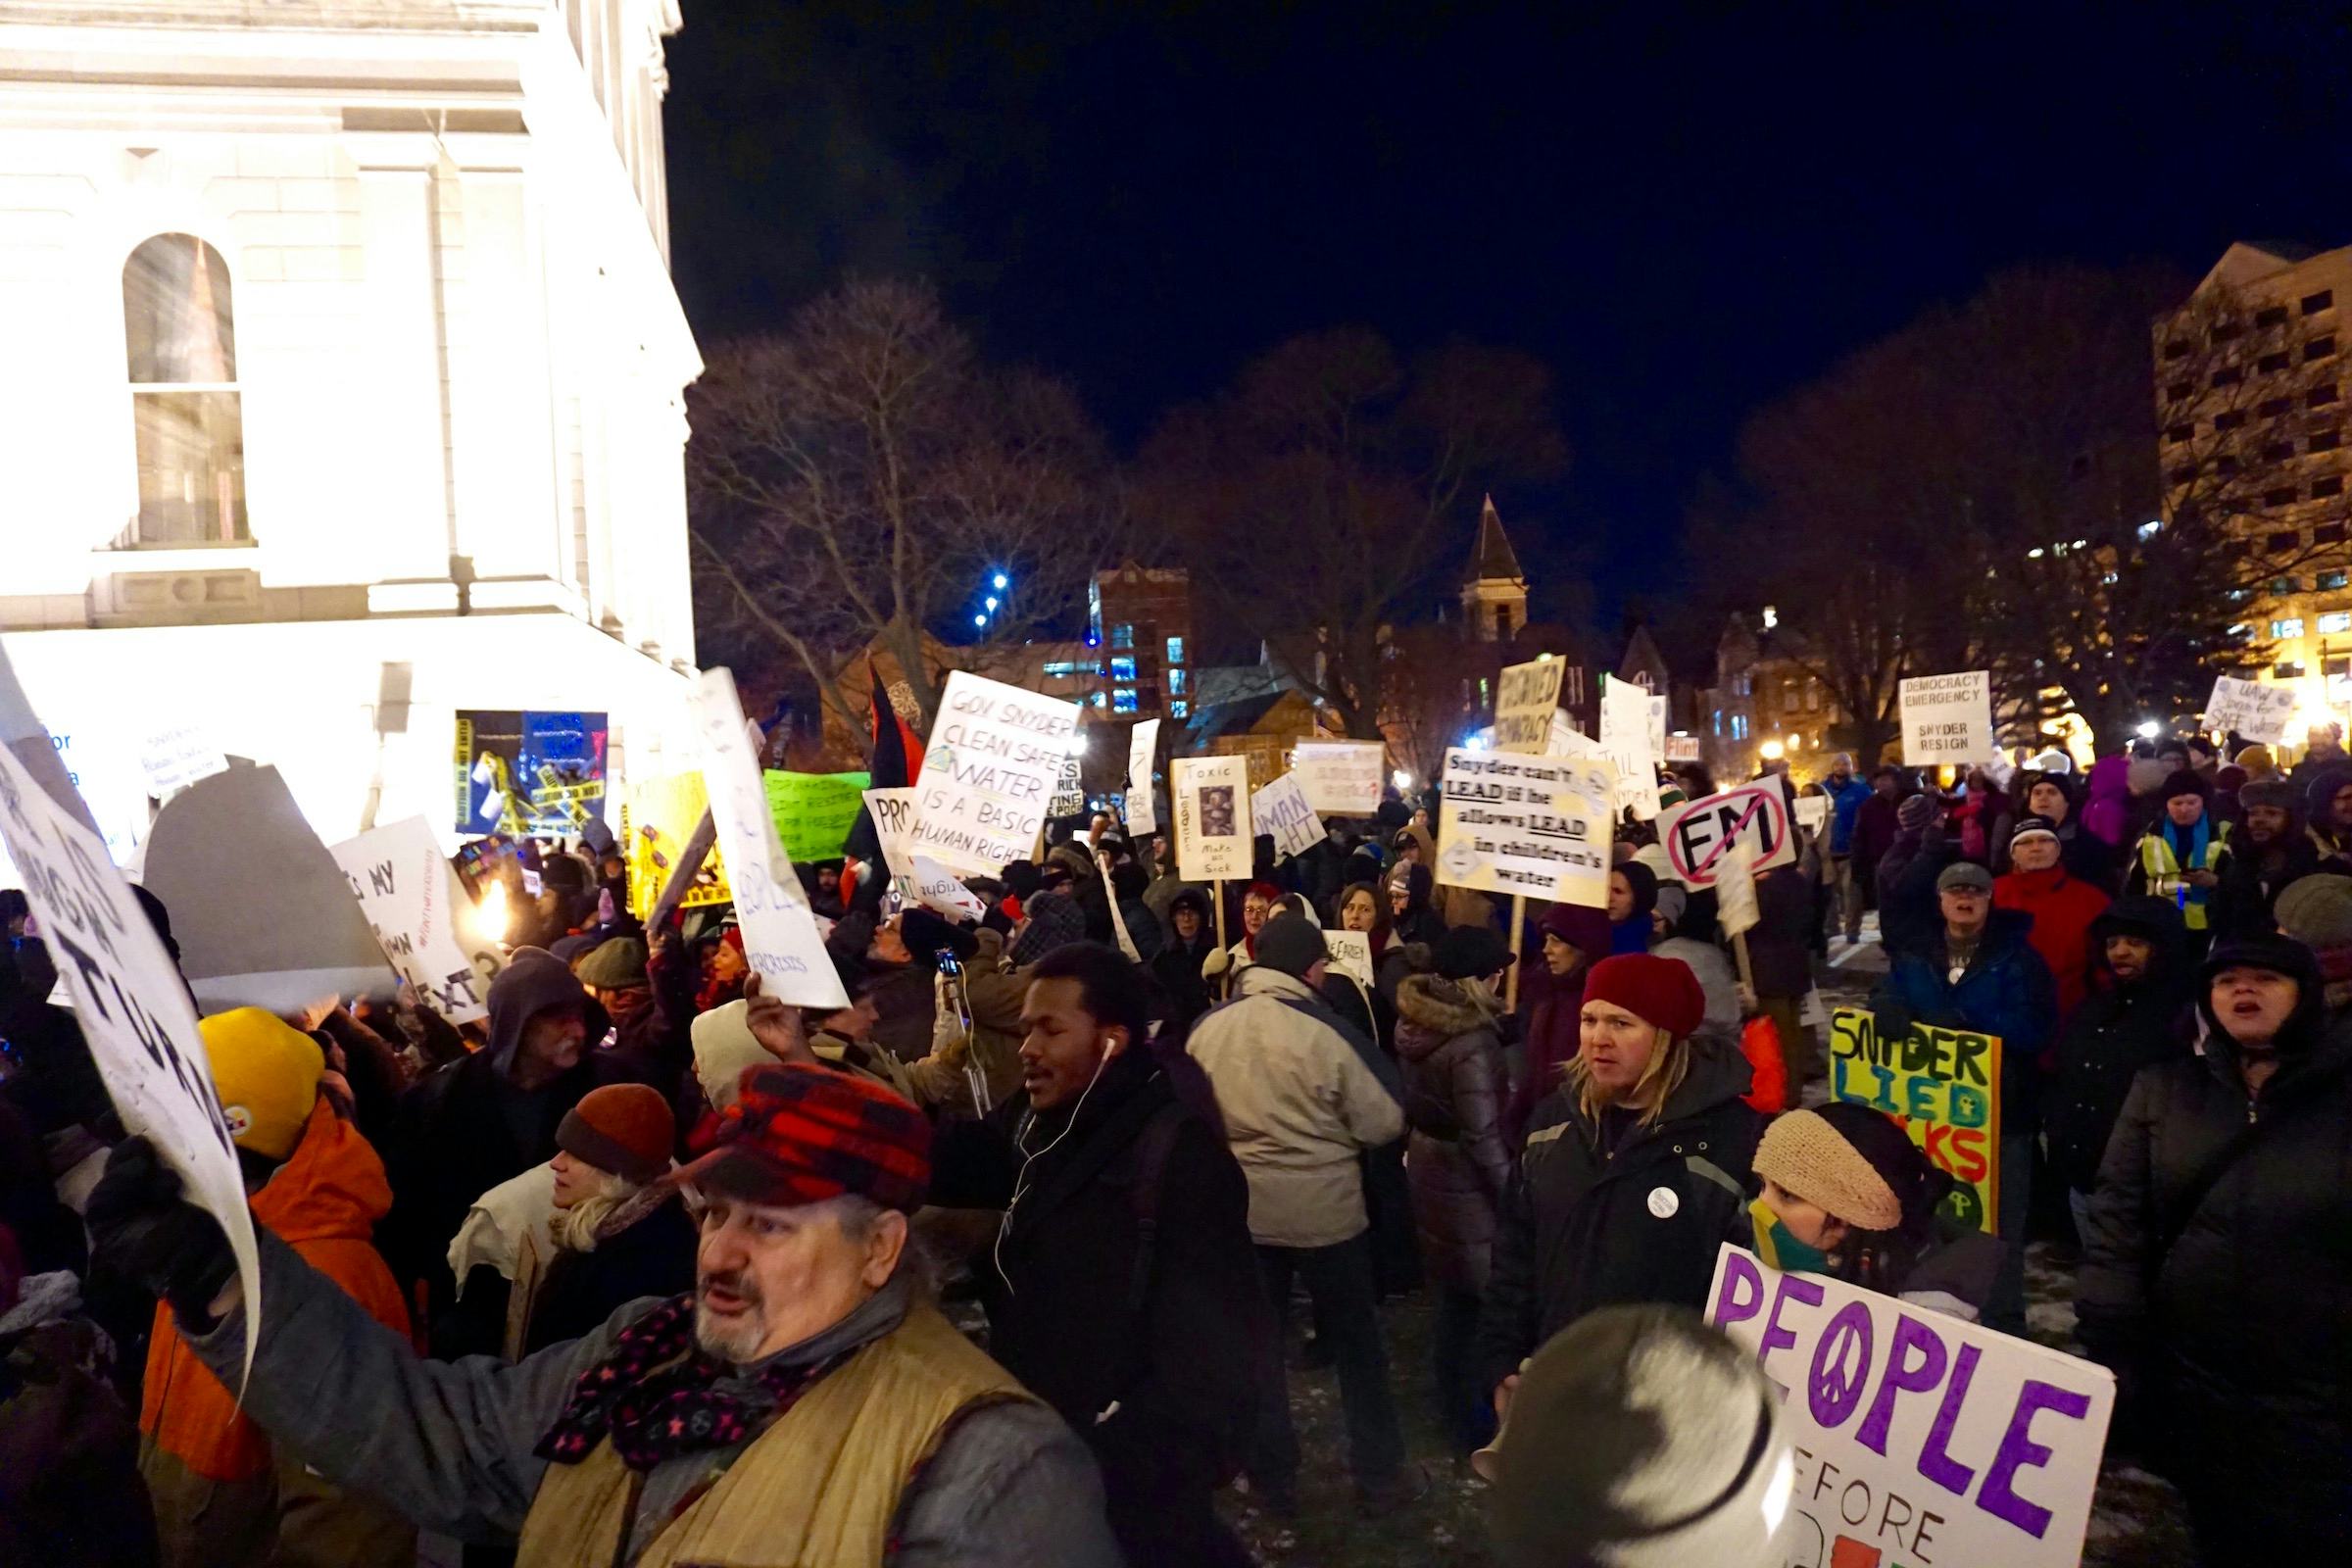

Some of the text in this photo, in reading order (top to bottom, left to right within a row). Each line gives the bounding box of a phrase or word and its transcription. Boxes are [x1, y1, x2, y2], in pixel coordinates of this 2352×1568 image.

[1905, 689, 1980, 707] EMERGENCY
[1906, 674, 1981, 692] DEMOCRACY
[952, 691, 1072, 735] GOV SNYDER
[1919, 722, 1968, 737] SNYDER
[944, 724, 1065, 772] CLEAN SAFE
[1921, 738, 1969, 751] RESIGN
[950, 751, 1043, 802] WATER
[1449, 755, 1573, 782] Snyder can't
[1446, 780, 1552, 805] LEAD if he
[922, 789, 1037, 835] IS A BASIC
[1457, 808, 1588, 836] allows LEAD
[910, 819, 1032, 865] HUMAN RIGHT
[1473, 837, 1603, 868] in children's
[368, 860, 395, 897] MY
[1494, 868, 1556, 888] water
[1835, 1055, 1988, 1128] LIED
[1714, 1252, 2092, 1540] PEOPLE
[1794, 1446, 1945, 1564] EFORE
